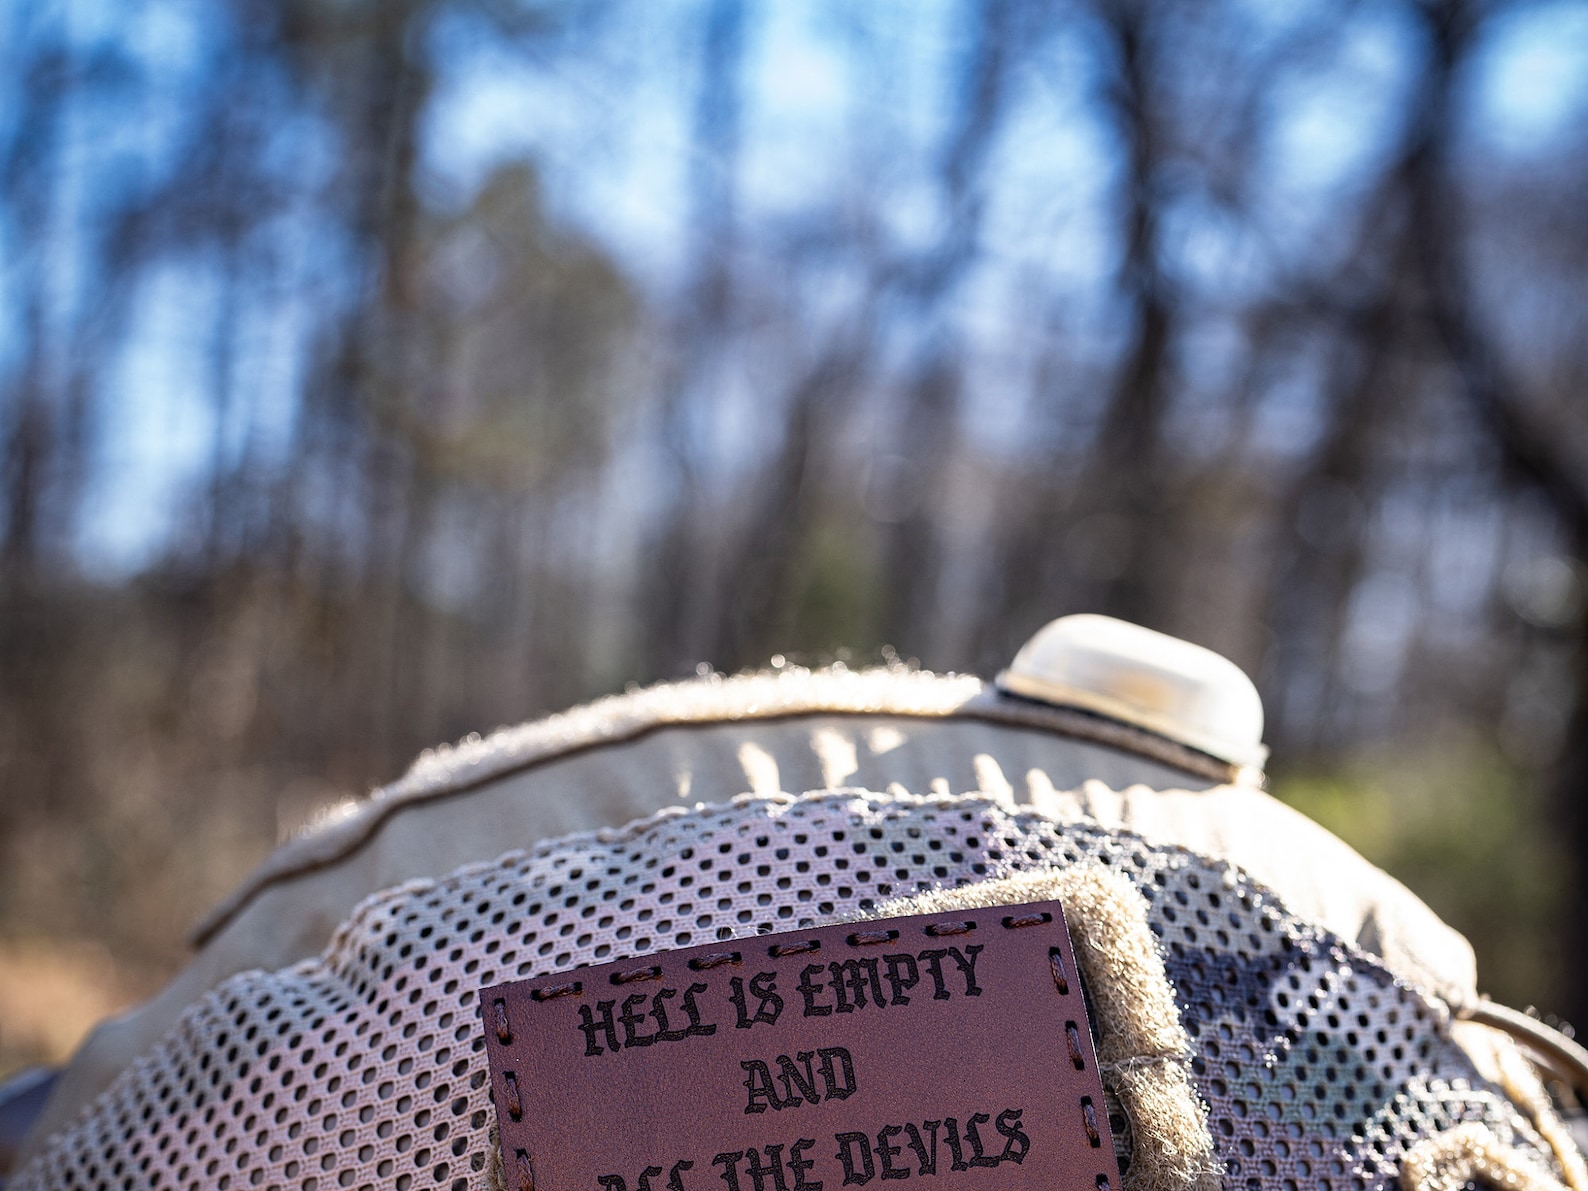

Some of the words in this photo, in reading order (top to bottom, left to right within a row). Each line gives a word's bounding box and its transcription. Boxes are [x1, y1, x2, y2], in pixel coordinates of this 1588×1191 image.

[577, 983, 716, 1057] HELL
[730, 971, 784, 1029] IS
[797, 944, 984, 1017] EMPTY
[741, 1046, 857, 1114] AND
[835, 1108, 1031, 1187] DEVILS
